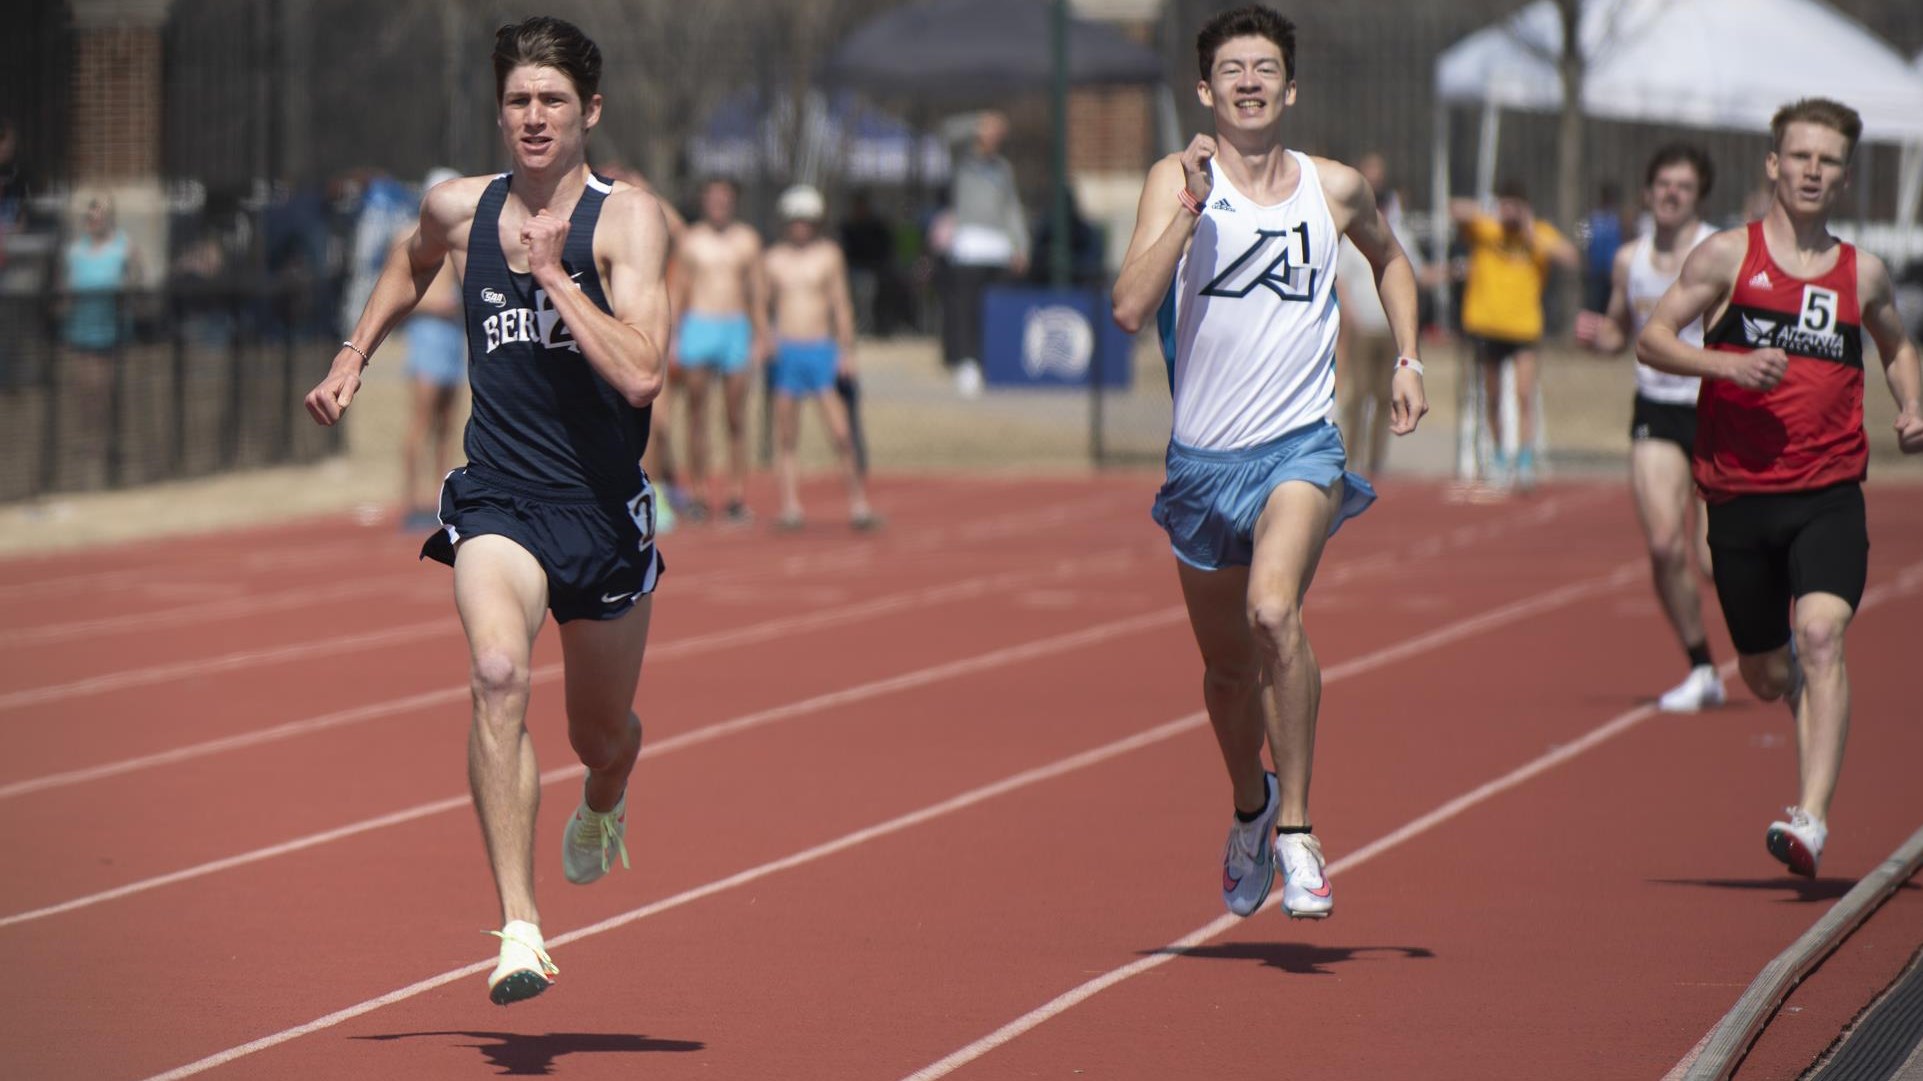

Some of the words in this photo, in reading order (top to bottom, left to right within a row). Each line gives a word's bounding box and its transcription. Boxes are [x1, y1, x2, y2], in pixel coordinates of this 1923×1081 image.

[1292, 221, 1310, 264] 1
[482, 308, 580, 354] BER
[1804, 292, 1831, 332] 5
